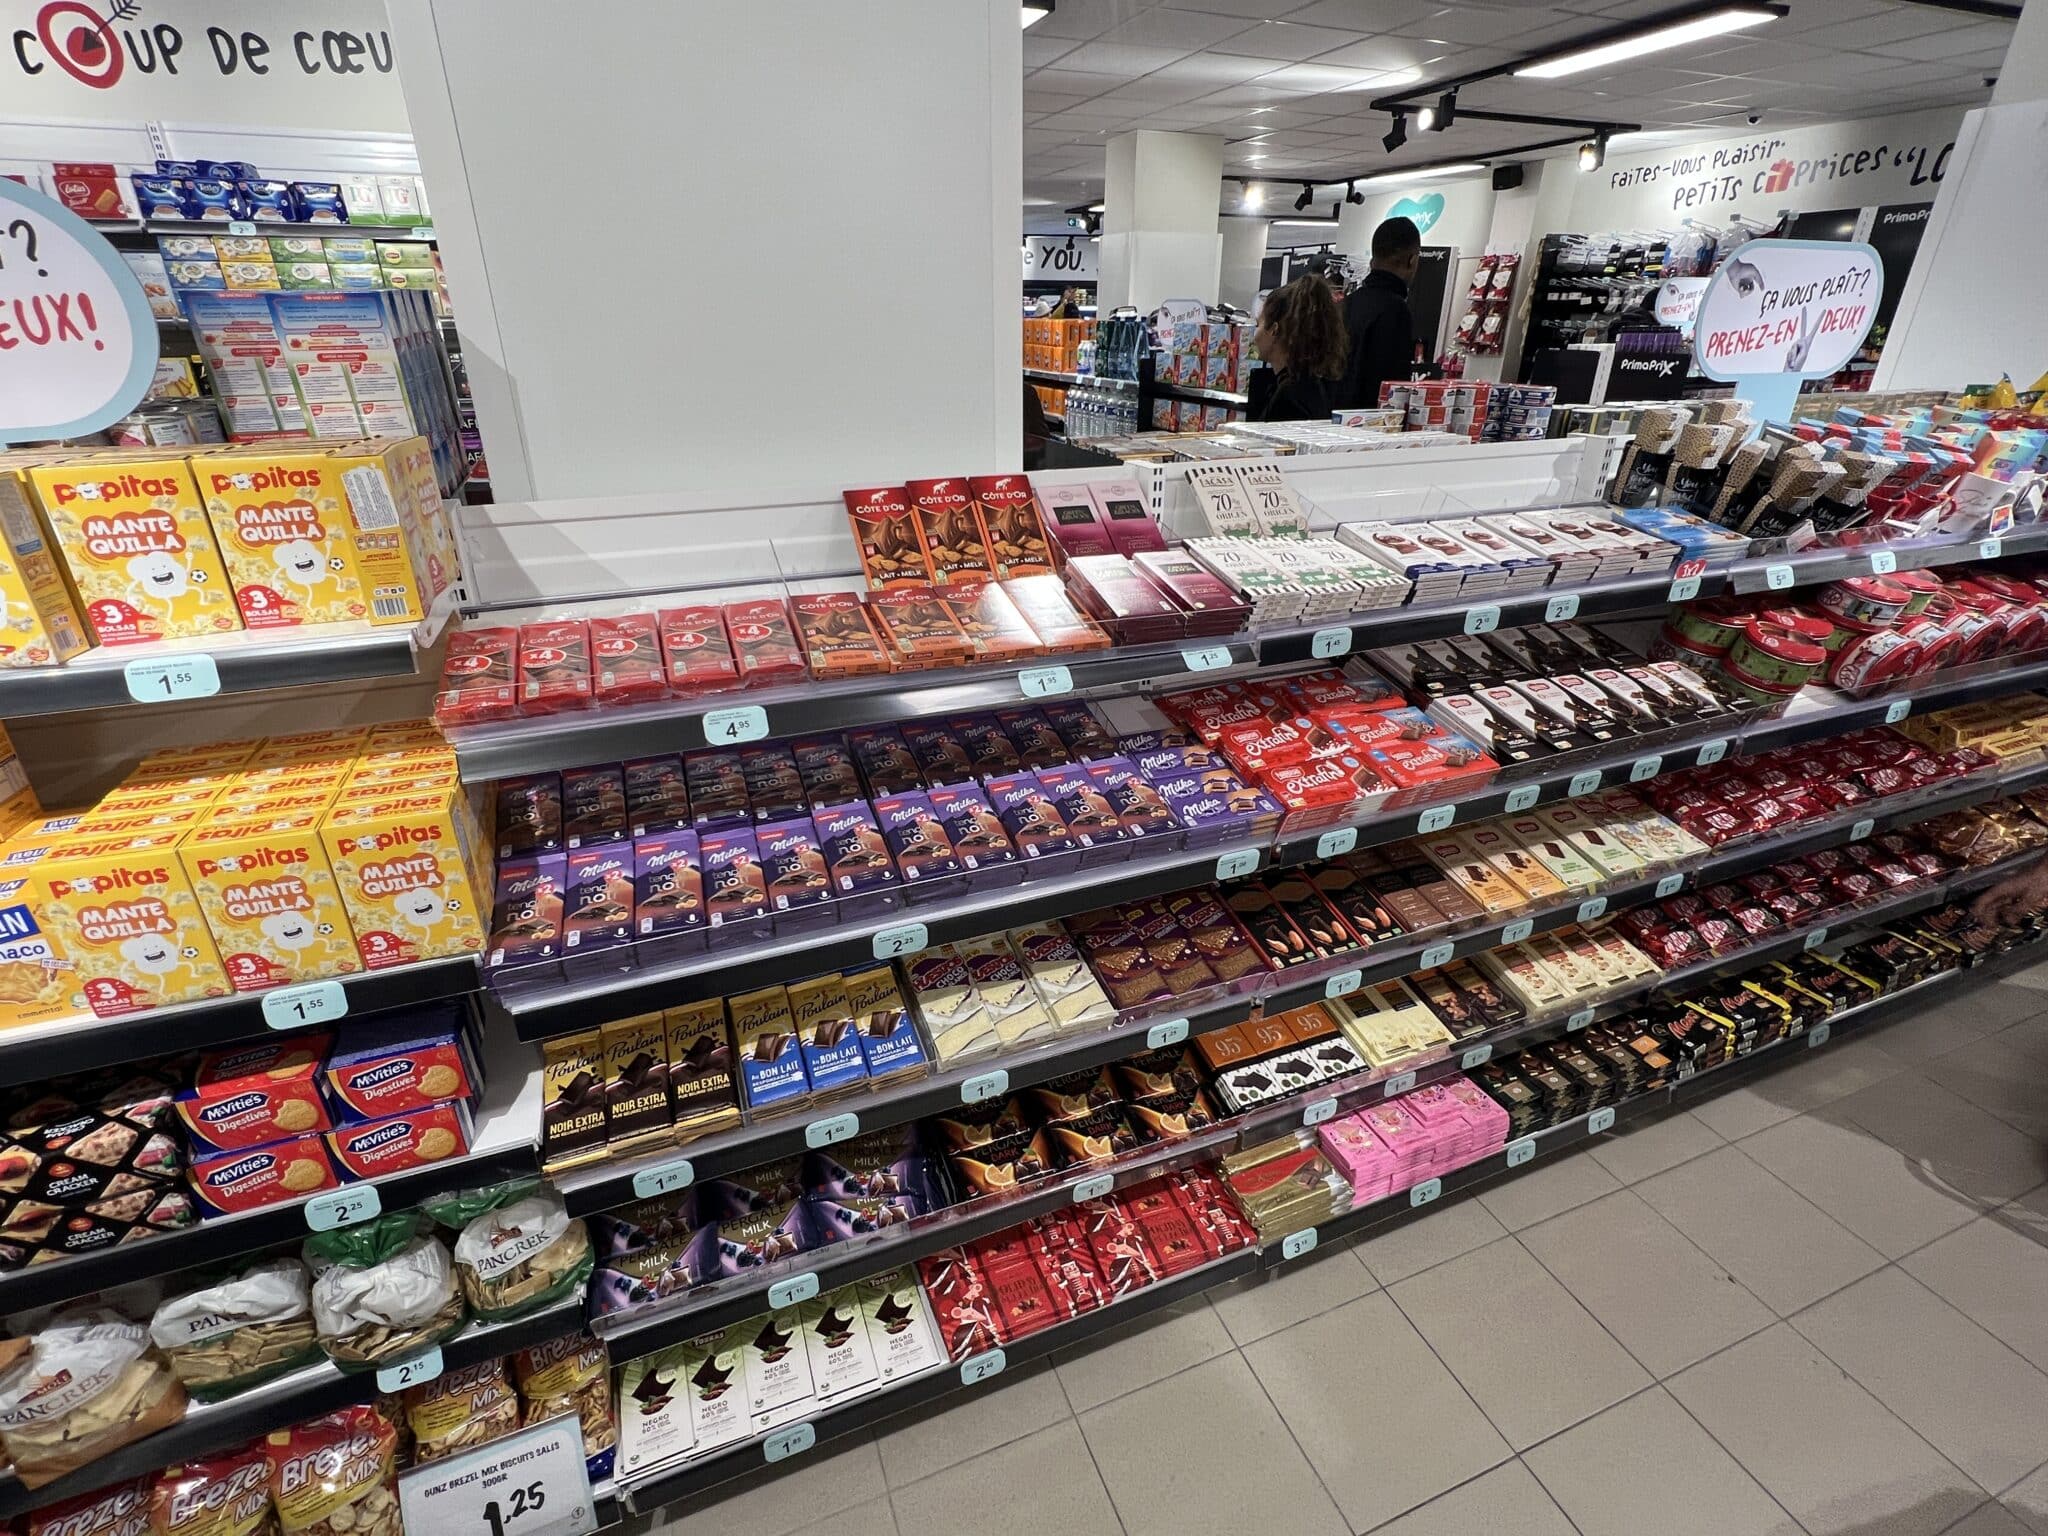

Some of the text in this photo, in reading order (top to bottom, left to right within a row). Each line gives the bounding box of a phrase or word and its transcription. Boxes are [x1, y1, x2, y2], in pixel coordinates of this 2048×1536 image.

[1781, 280, 1817, 309] VOUS
[1819, 266, 1871, 300] PLAÎT?
[1706, 305, 1866, 359] PRENEZ-EN DEUX!
[53, 475, 179, 505] popitas
[211, 466, 322, 494] popitas
[919, 495, 943, 506] CÔTE
[981, 491, 1006, 501] CÔTE
[239, 506, 314, 526] MANTE
[856, 503, 880, 515] CÔTE
[87, 516, 173, 537] MANTE
[241, 522, 324, 542] QUILLA
[90, 534, 182, 556] QUILLA
[251, 590, 268, 608] 3
[101, 605, 118, 623] 3
[245, 608, 280, 619] BOLSAS
[98, 623, 137, 635] BOLSAS
[1140, 750, 1177, 771] Milka
[1158, 777, 1196, 798] Milka
[1182, 795, 1223, 818] Milka
[828, 815, 865, 833] Milka
[337, 825, 442, 857] popitas
[769, 834, 808, 852] Milka
[197, 848, 310, 878] popitas
[646, 850, 689, 868] Milka
[708, 845, 749, 865] Milka
[363, 859, 434, 880] MANTE
[578, 860, 623, 878] Milka
[49, 864, 171, 899] popitas
[226, 881, 304, 902] MANTE
[363, 872, 442, 894] QUILLA
[82, 902, 164, 925] MANTE
[227, 896, 312, 918] QUILLA
[84, 918, 174, 940] QUILLA
[374, 935, 388, 952] 3
[366, 948, 399, 961] BOLSAS
[239, 957, 255, 974] 3
[234, 973, 268, 983] BOLSAS
[93, 996, 130, 1007] BOLSAS
[99, 983, 115, 1000] 3
[849, 984, 898, 1013] Poulain
[796, 992, 846, 1022] Poulain
[669, 1016, 724, 1042] Poulain
[737, 1005, 790, 1034] Poulain
[606, 1032, 664, 1061] Poulain
[820, 1044, 858, 1064] BON LAIT
[878, 1035, 913, 1055] BON LAIT
[759, 1059, 799, 1079] BON LAIT
[364, 1075, 416, 1102] Digestives
[677, 1072, 730, 1097] NOIR EXTRA
[612, 1091, 667, 1116] NOIR EXTRA
[215, 1108, 271, 1135] Digestives
[549, 1110, 606, 1136] NOIR EXTRA
[362, 1137, 414, 1164] Digestives
[46, 1177, 98, 1197] CRACKER
[49, 1173, 88, 1190] CREAM
[223, 1169, 278, 1198] Digestives
[68, 1228, 106, 1244] CREAM
[742, 1219, 773, 1238] MILK
[65, 1232, 115, 1249] CRACKER
[476, 1229, 550, 1273] PANCREK
[639, 1253, 668, 1271] MILK
[449, 1470, 479, 1490] BREZEL
[481, 1464, 499, 1479] MIX
[500, 1450, 535, 1471] BISCUITS
